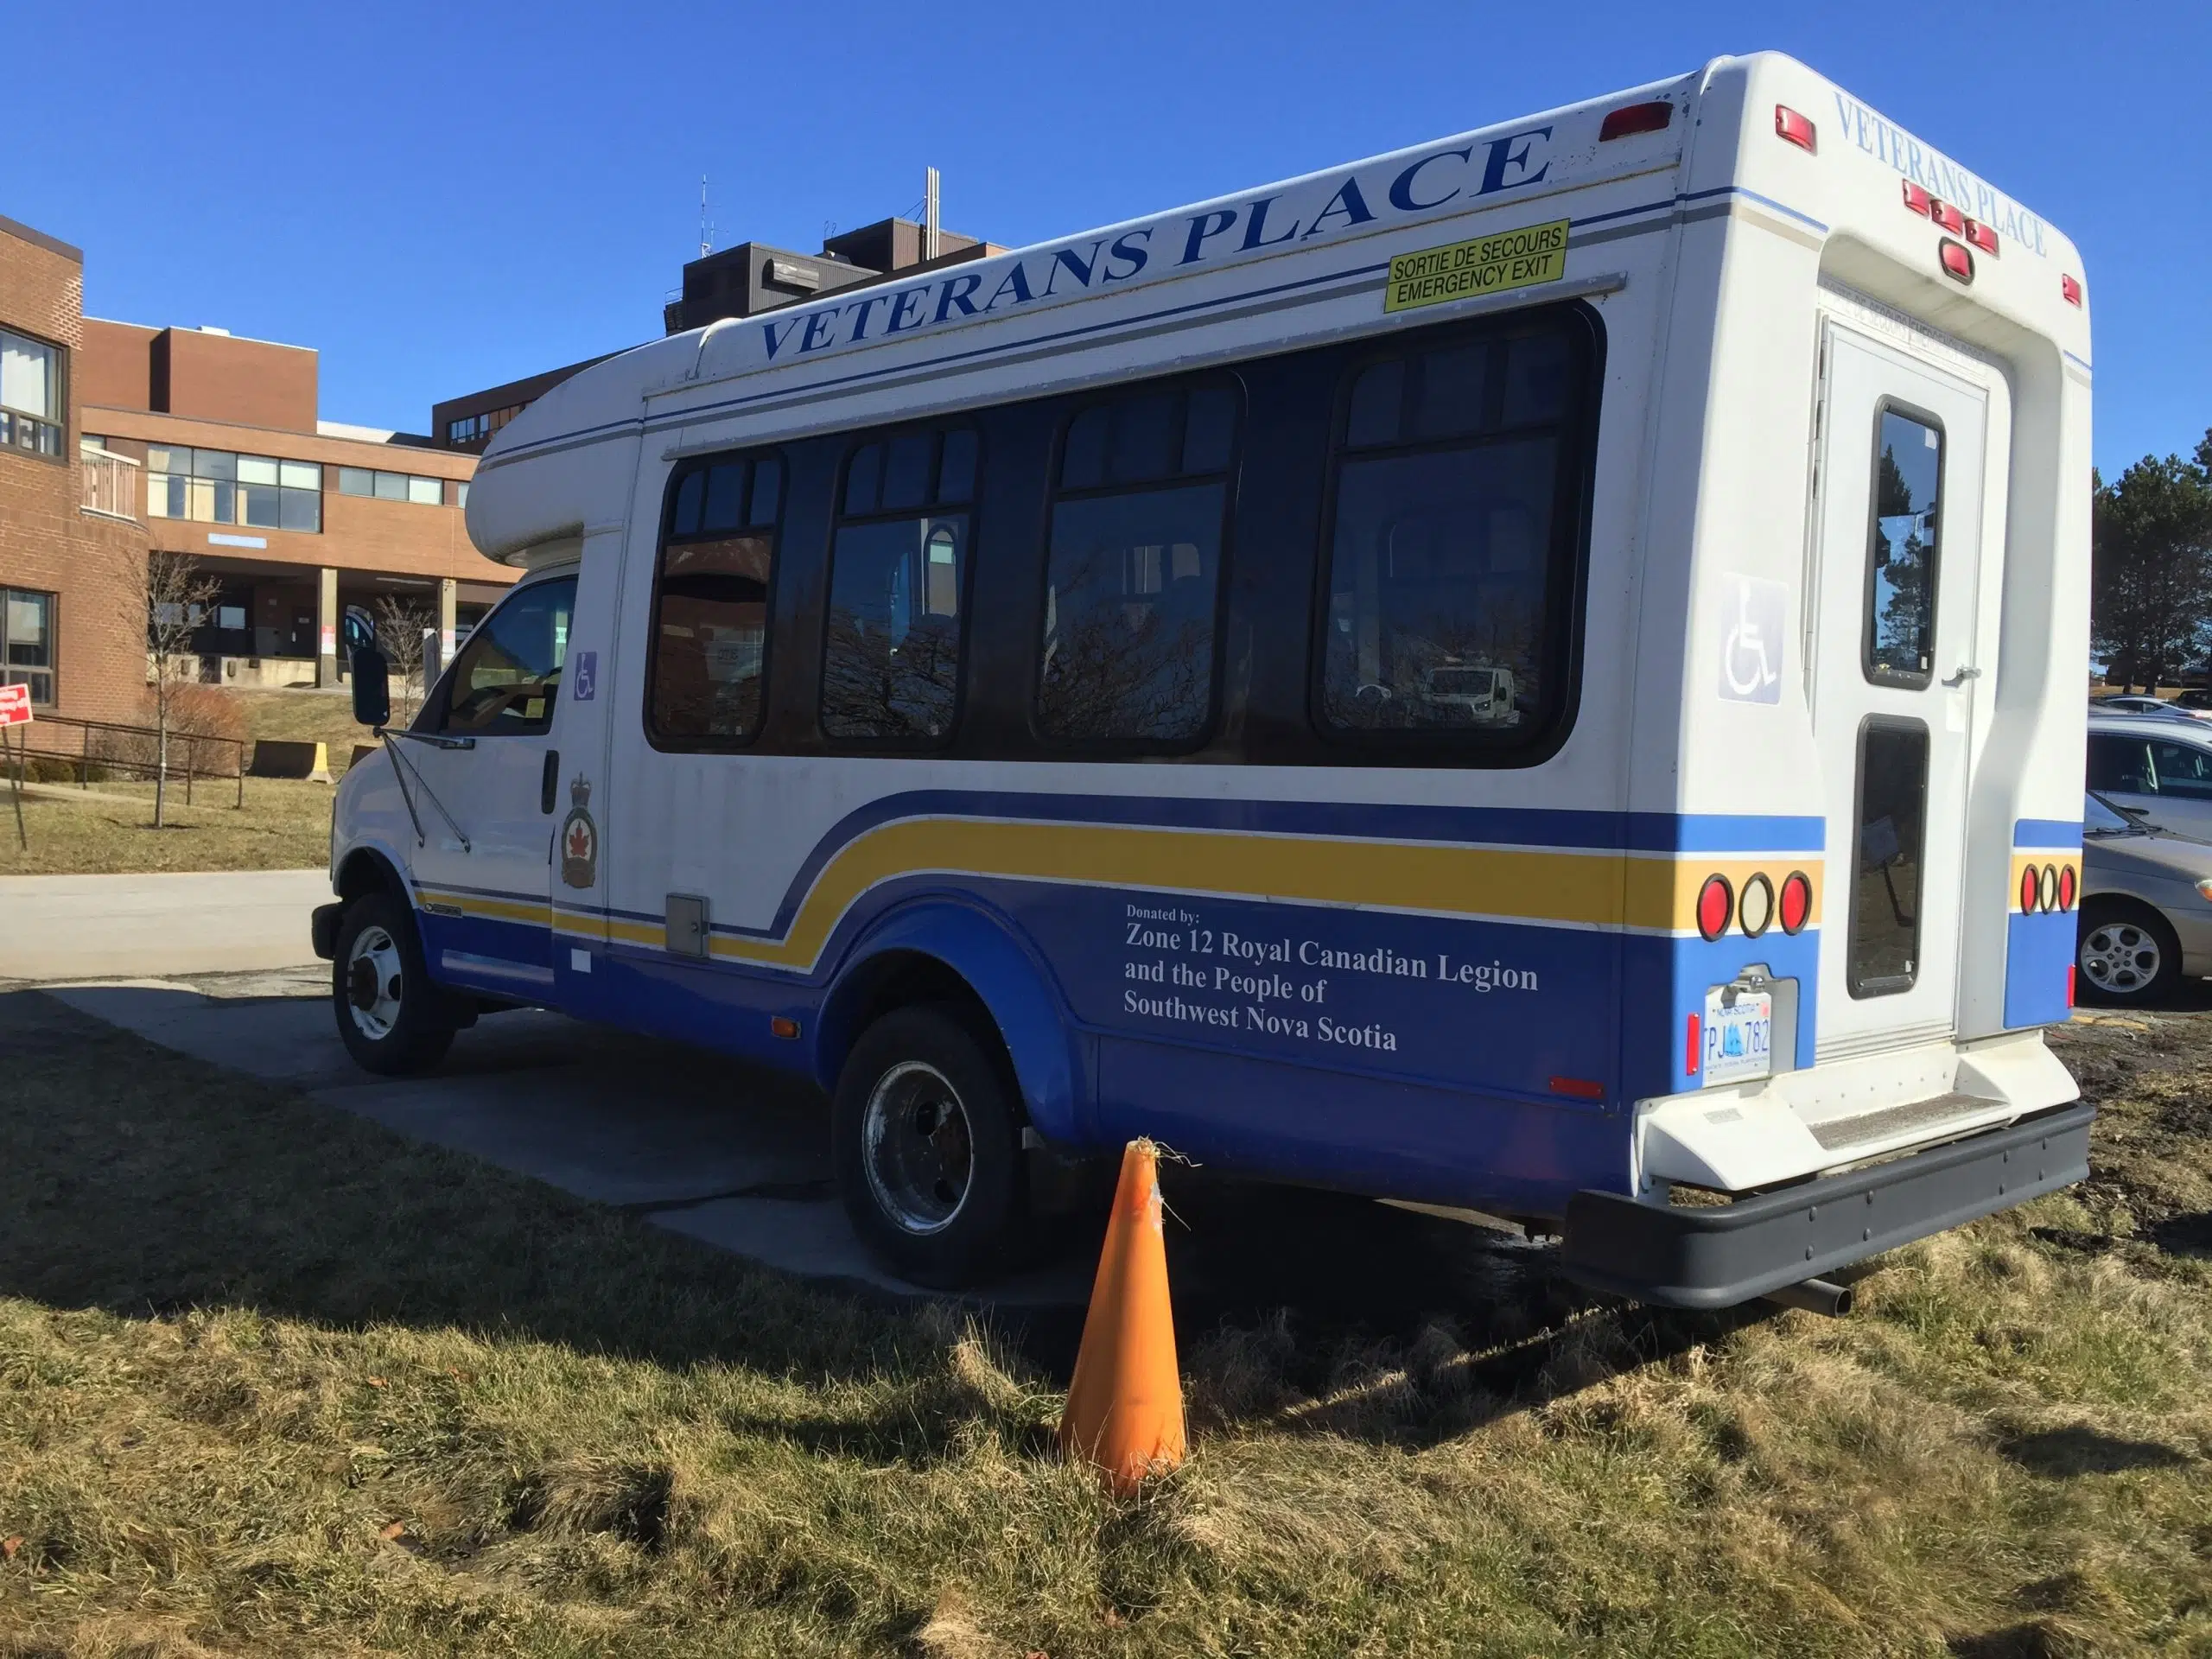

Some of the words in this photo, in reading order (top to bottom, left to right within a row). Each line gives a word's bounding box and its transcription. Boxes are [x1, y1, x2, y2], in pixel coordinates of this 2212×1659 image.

[1834, 91, 1971, 212] VETERANS
[1974, 180, 2047, 258] PLACE
[761, 229, 1154, 361] VETERANS
[1175, 126, 1553, 266] PLACE
[1395, 251, 1451, 280] SORTIE
[1454, 245, 1477, 268] DE
[1480, 227, 1562, 263] SECOURS
[1397, 264, 1508, 303] EMERGENCY
[1511, 255, 1553, 281] EXIT
[1126, 904, 1177, 922] Donated
[1179, 910, 1200, 926] by:
[1125, 960, 1165, 982] and
[1173, 963, 1207, 988] the
[1214, 967, 1294, 1002] People
[1300, 980, 1328, 1003] of
[1126, 923, 1180, 950] Zone
[1189, 928, 1213, 953] 12
[1222, 931, 1291, 966] Royal
[1299, 940, 1427, 978] Canadian
[1437, 954, 1538, 993] Legion
[1124, 990, 1239, 1027] Southwest
[1246, 1007, 1309, 1038] Nova
[1317, 1017, 1397, 1052] Scotia
[1745, 1019, 1770, 1054] 782
